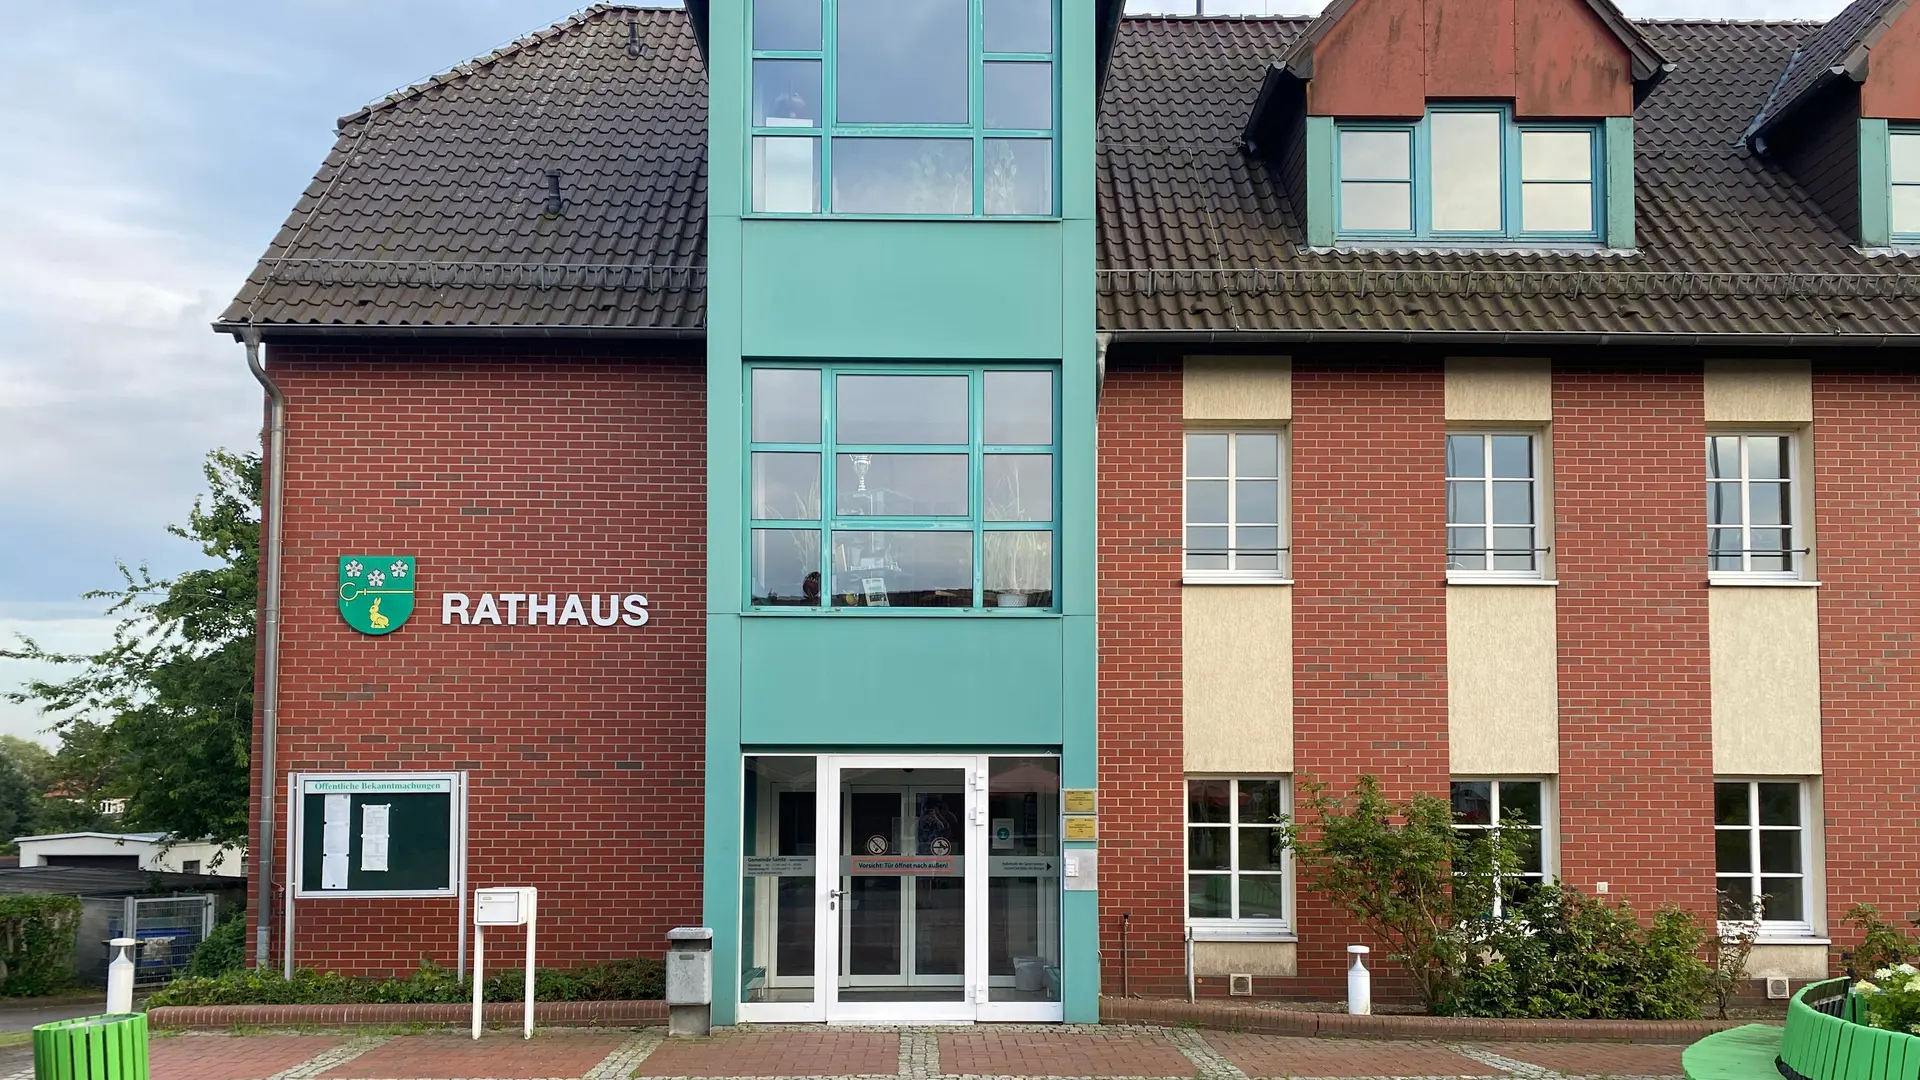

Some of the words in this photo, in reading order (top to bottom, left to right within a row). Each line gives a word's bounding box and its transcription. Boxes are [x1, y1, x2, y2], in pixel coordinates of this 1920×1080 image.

[442, 593, 649, 627] RATHAUS
[314, 781, 359, 790] Öffentliche
[361, 782, 441, 790] Bekanntmachungen
